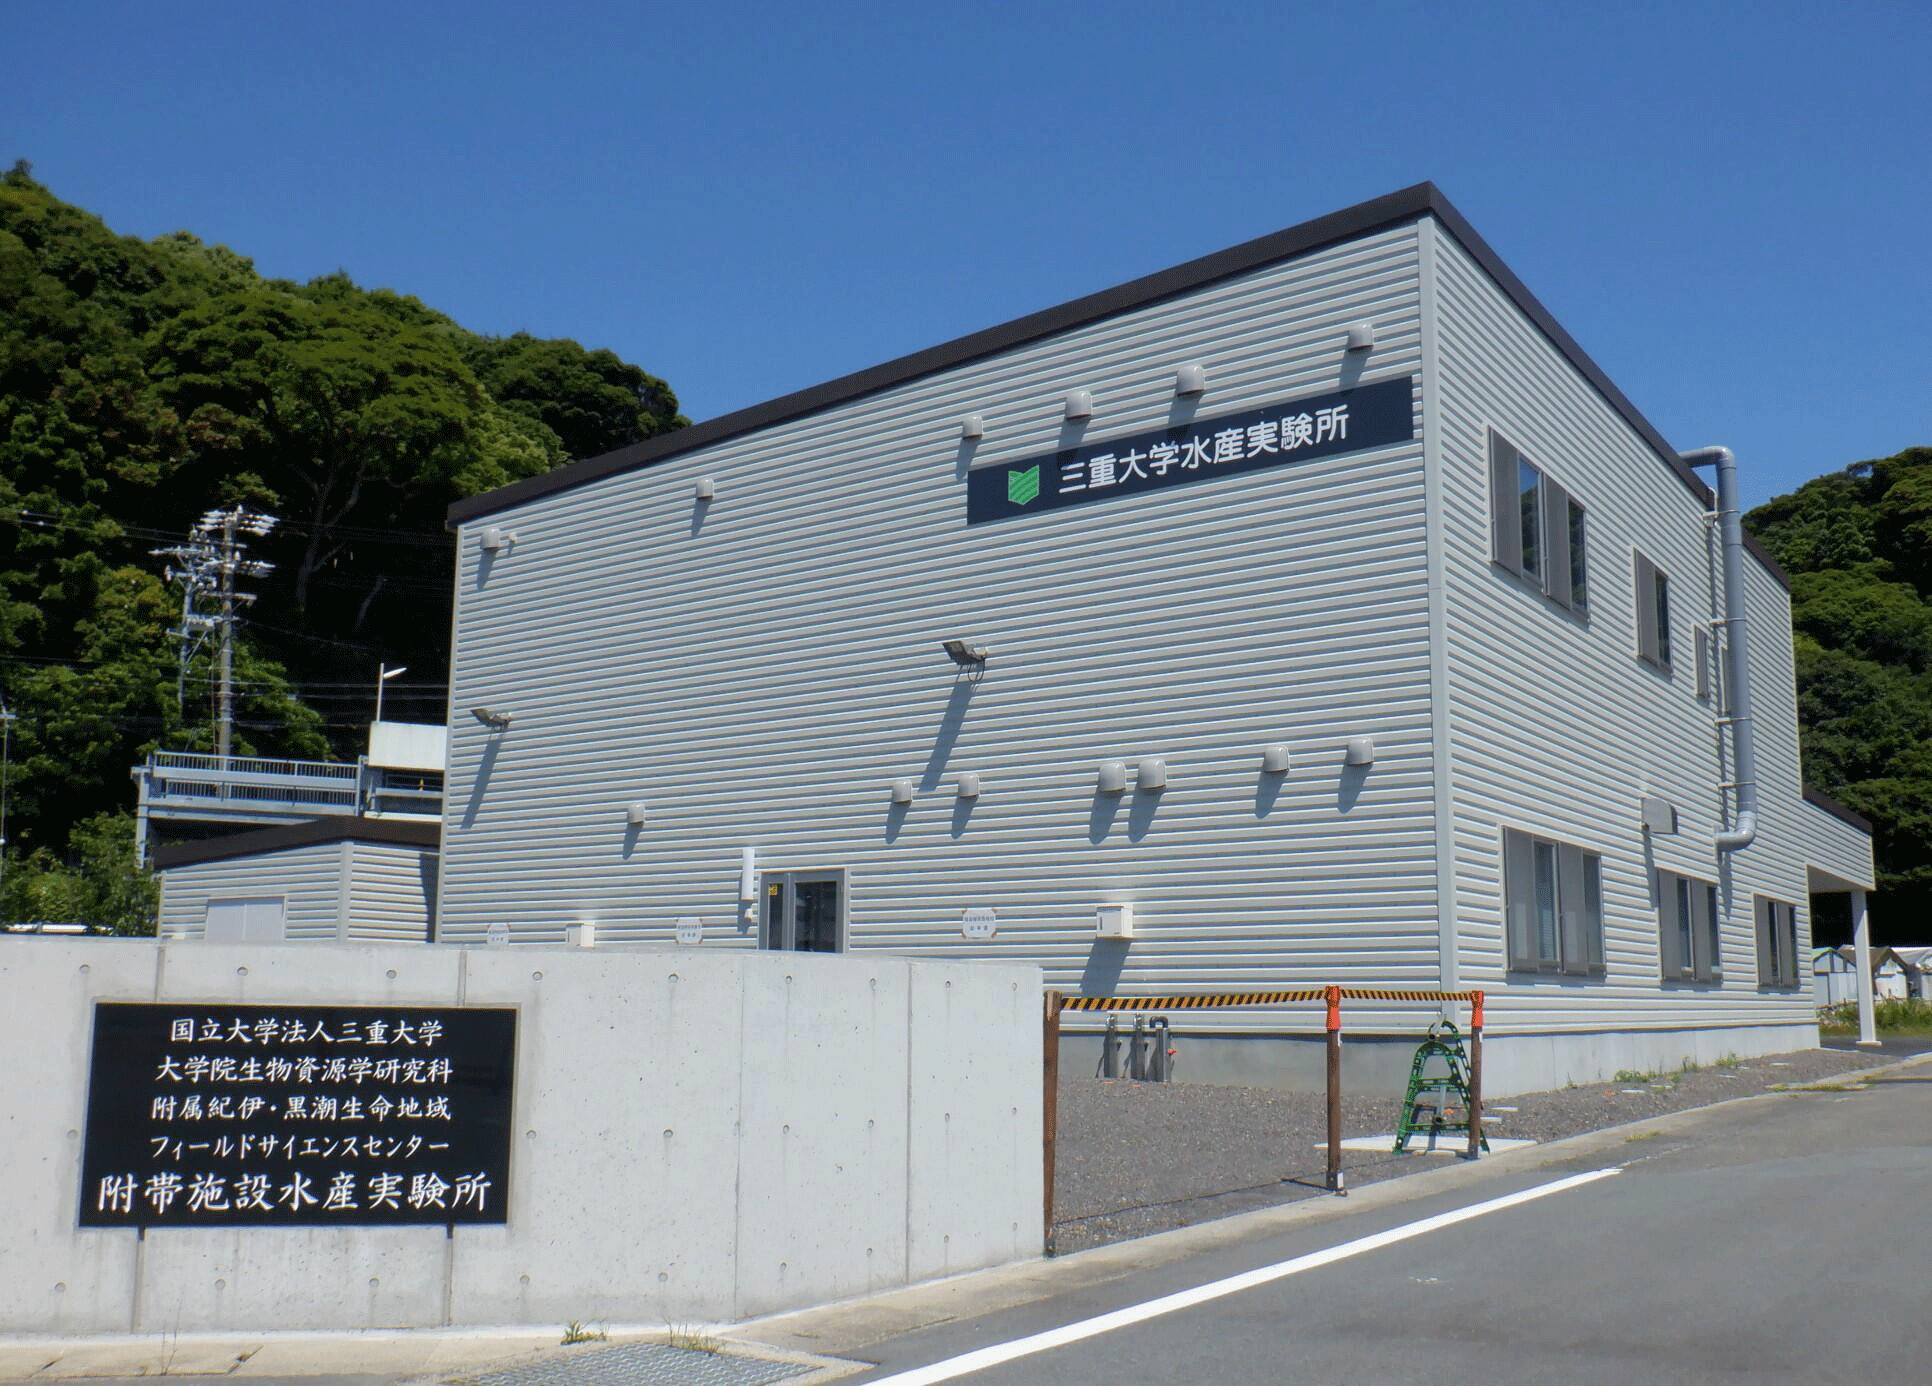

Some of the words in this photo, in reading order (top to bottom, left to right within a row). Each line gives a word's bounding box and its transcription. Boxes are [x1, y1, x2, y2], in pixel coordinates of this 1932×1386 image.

[1059, 404, 1349, 493] 三重大学水産実験所
[171, 1018, 443, 1046] 国立大学法人三重大学
[155, 1056, 453, 1084] 大学院生物資源学研究科
[151, 1095, 452, 1121] 附属紀伊・黒潮生命地域
[150, 1134, 449, 1160] フィールドサイエンスセンター
[98, 1171, 491, 1214] 附帯施設水産実験所
